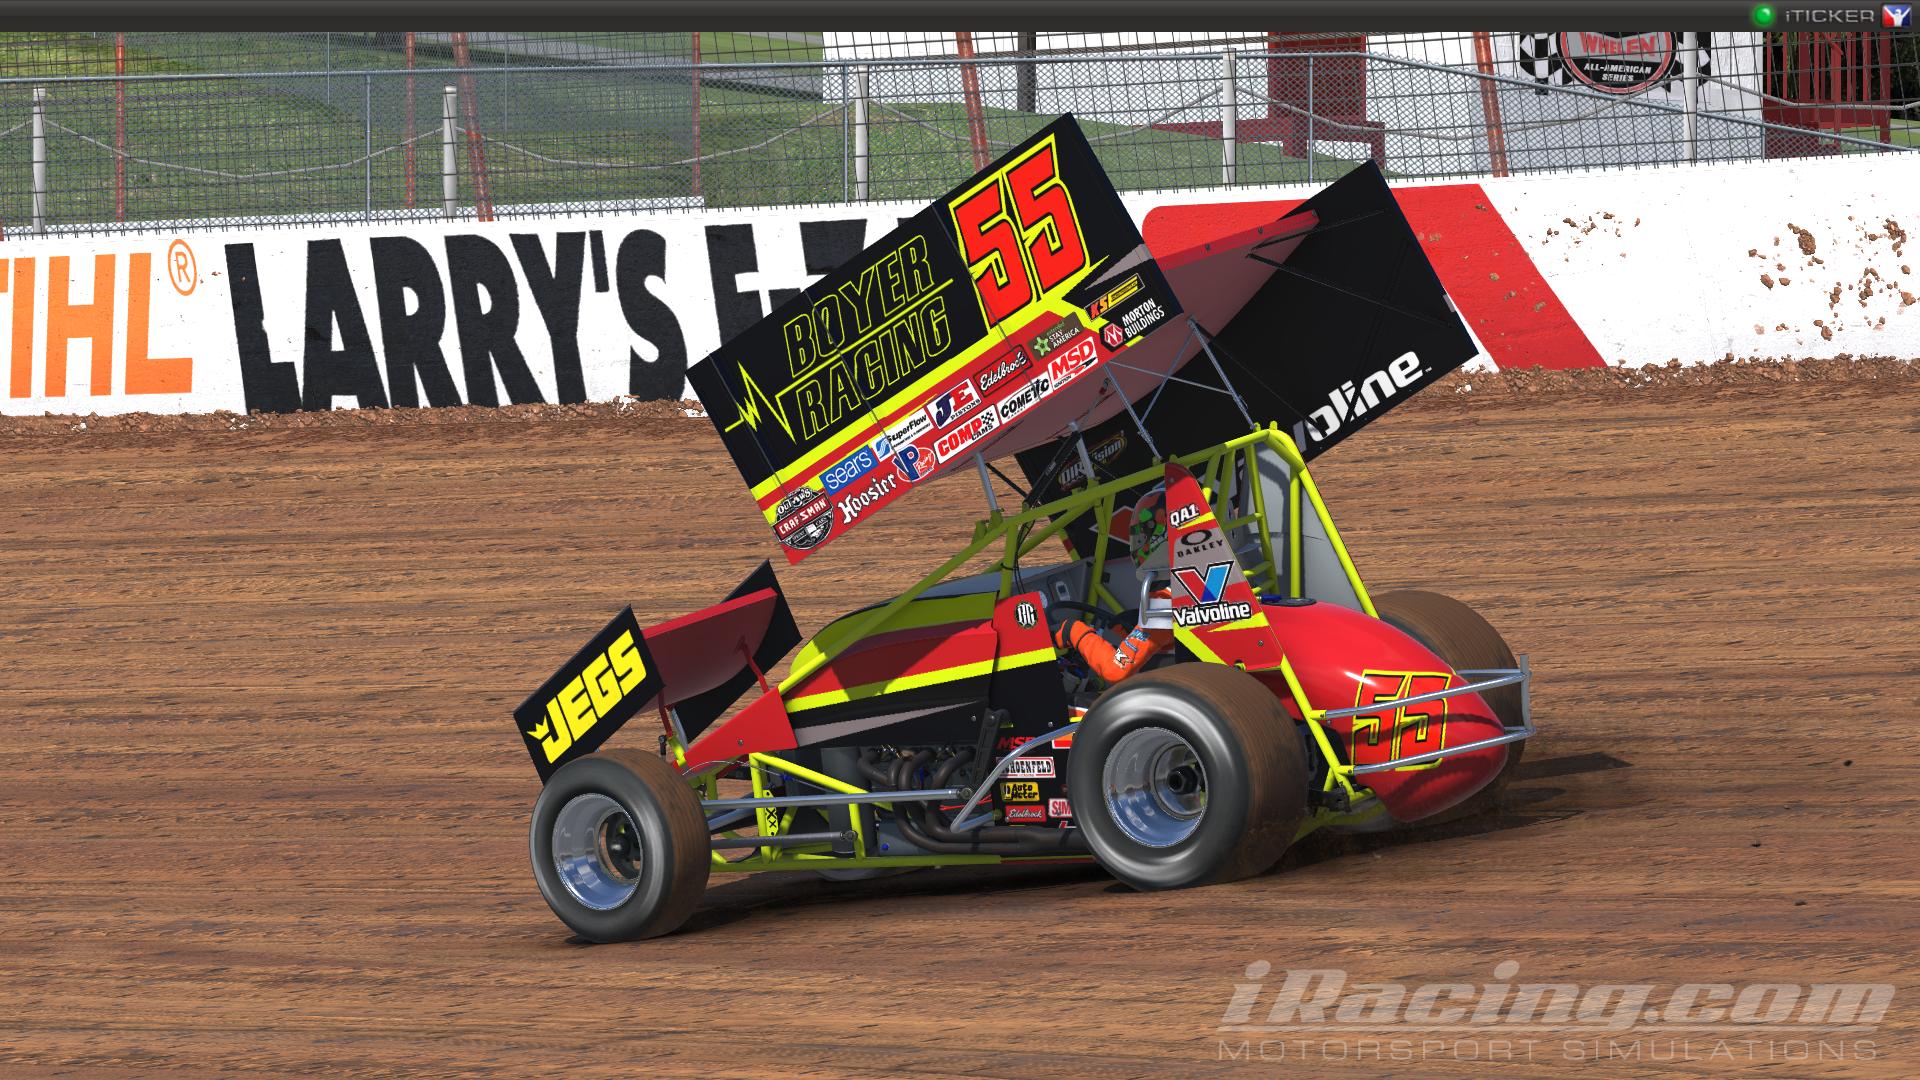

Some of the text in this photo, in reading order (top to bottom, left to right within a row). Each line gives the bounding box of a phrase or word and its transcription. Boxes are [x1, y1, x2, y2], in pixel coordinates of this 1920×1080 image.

[1584, 62, 1652, 75] ALL-AMERICAN
[1602, 73, 1634, 83] SERIES
[950, 137, 1090, 332] 55
[225, 228, 687, 415] LARRY'S
[784, 234, 935, 379] BOYER
[1121, 297, 1157, 327] MORTON
[1124, 305, 1165, 339] BUILDINGS
[0, 252, 193, 399] IHL
[1048, 329, 1064, 343] STAY
[1052, 327, 1081, 349] AMERICA
[796, 295, 952, 441] RACING
[1051, 340, 1094, 381] MSD
[950, 398, 981, 421] PISTONS
[937, 417, 983, 457] COMP
[971, 423, 994, 441] CAMS
[825, 451, 872, 490] sears
[837, 473, 897, 525] Hoosier
[1170, 503, 1200, 528] QA1
[1176, 539, 1224, 558] OAKLEY
[1172, 602, 1252, 627] Valvoline
[541, 628, 647, 765] JEGS
[1351, 668, 1453, 771] 55
[1010, 790, 1038, 799] Meter
[1011, 783, 1033, 792] Auto
